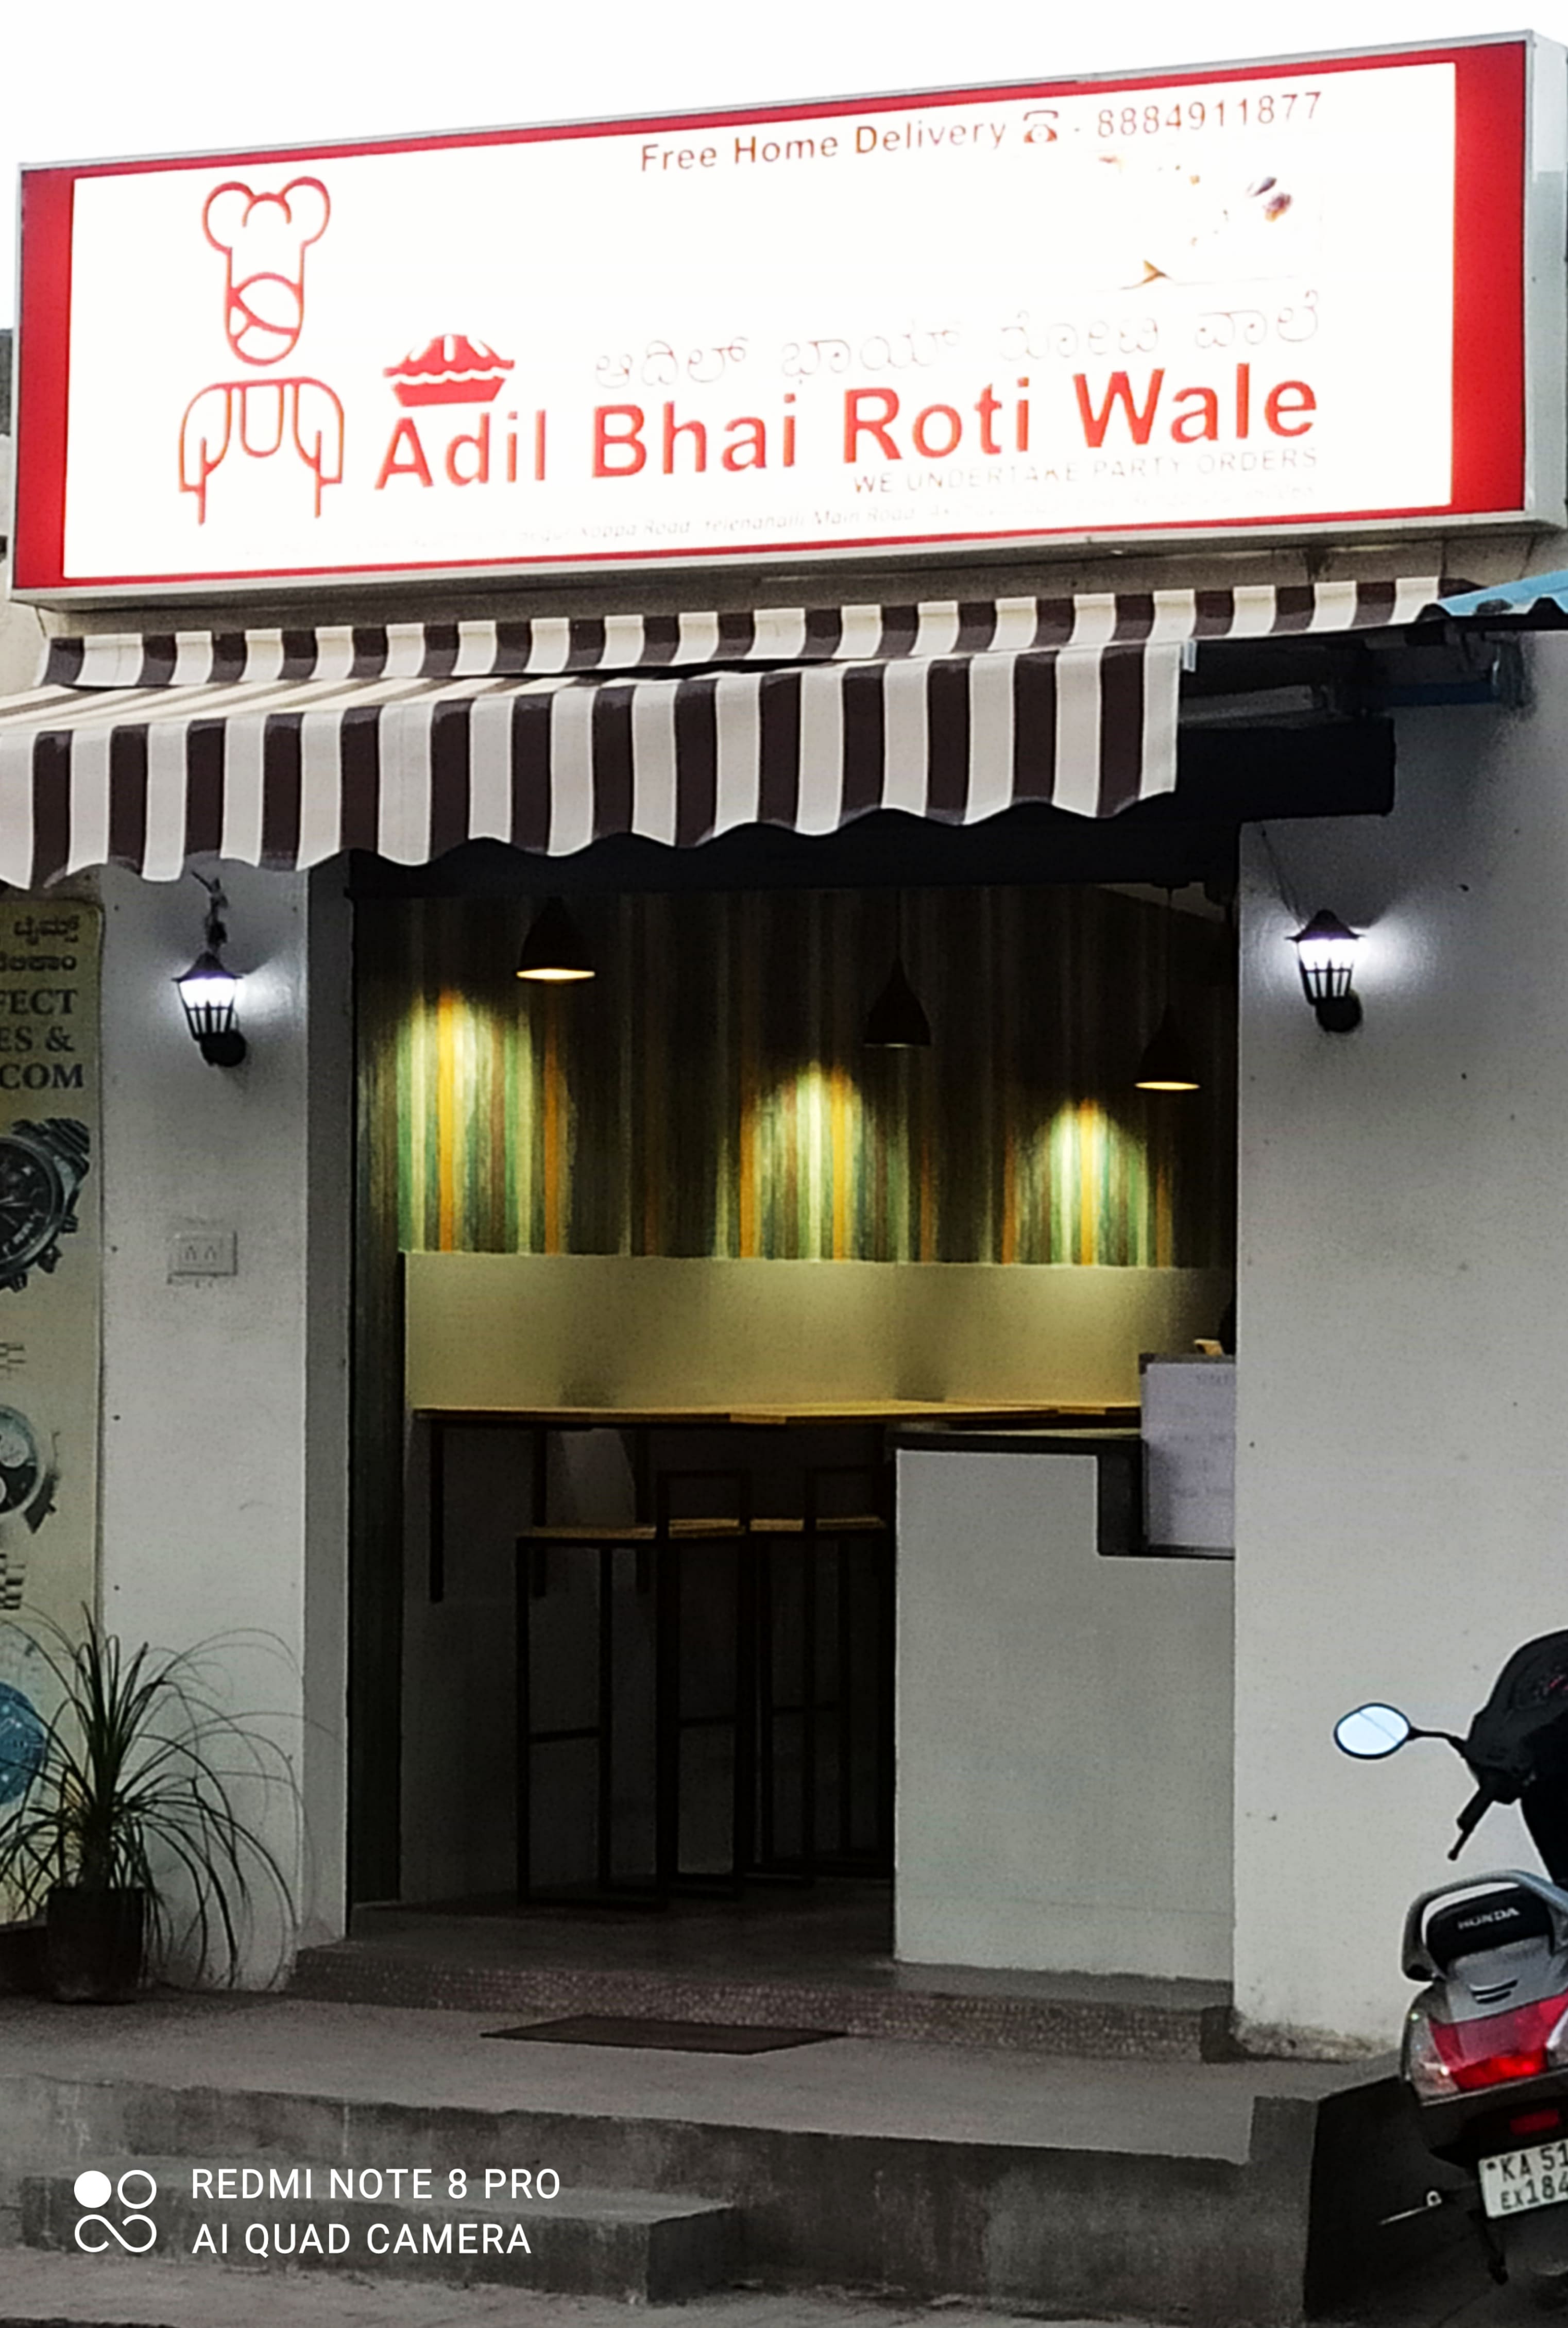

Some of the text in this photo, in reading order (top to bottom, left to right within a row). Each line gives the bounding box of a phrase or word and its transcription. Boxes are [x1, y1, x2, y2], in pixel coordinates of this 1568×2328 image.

[641, 143, 718, 172] Free
[734, 133, 839, 165] Home
[855, 119, 1007, 155] Delivery
[1097, 90, 1322, 139] 8884911877
[374, 361, 1318, 491] Adil Bhai Roti Wale
[853, 446, 1318, 495] WE UNDERTAKE PARTY ORDERS
[45, 1025, 75, 1052] &
[1457, 1906, 1520, 1930] HONDA
[1500, 2143, 1568, 2183] KA 51
